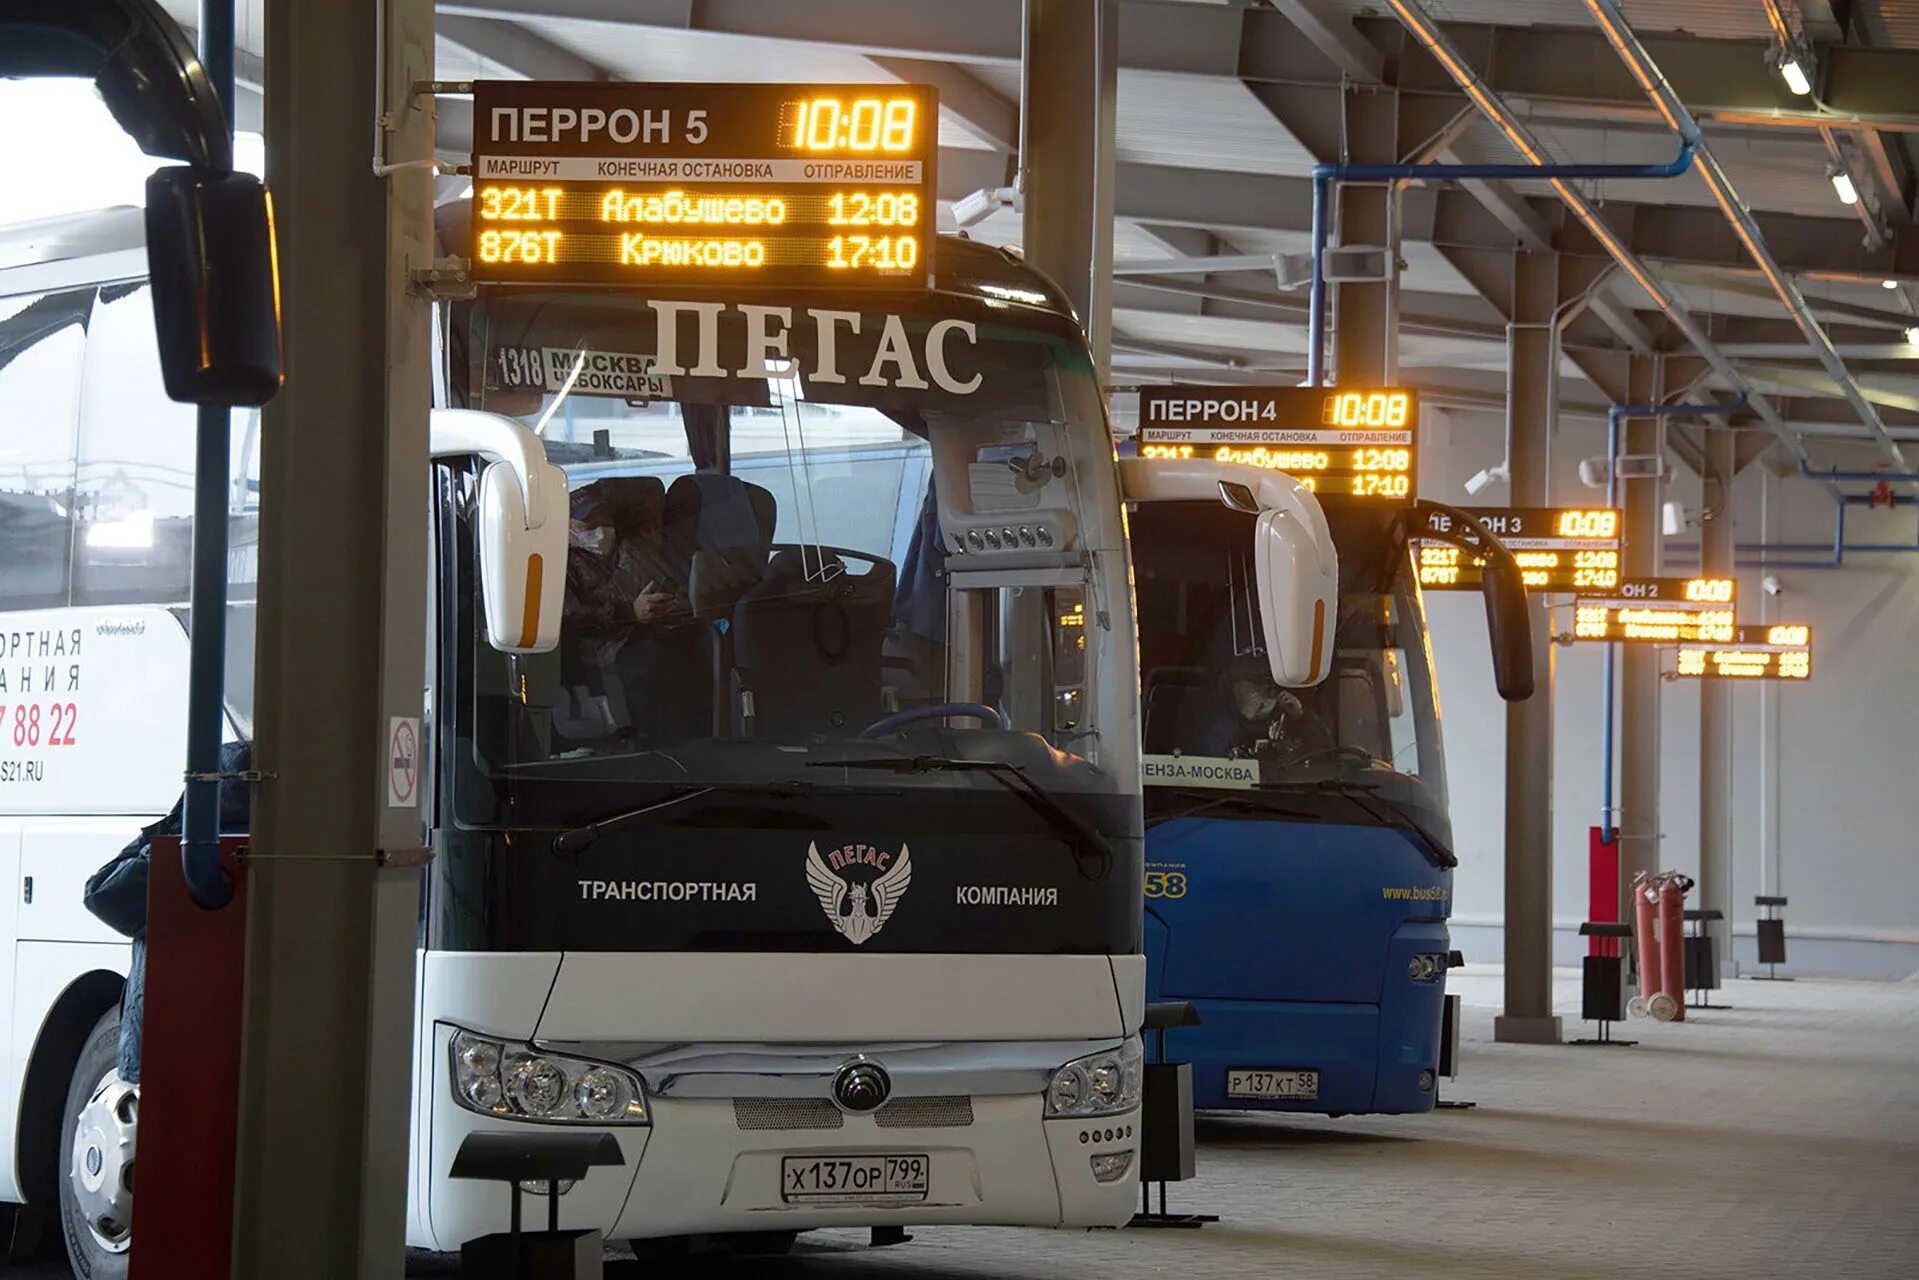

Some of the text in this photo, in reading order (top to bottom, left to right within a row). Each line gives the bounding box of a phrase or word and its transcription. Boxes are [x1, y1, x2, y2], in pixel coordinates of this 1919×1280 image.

[490, 107, 708, 145] ПЕРРОН 5
[794, 99, 915, 151] 10:08
[486, 159, 560, 176] МАРШРУТ
[598, 161, 774, 178] КОНЕЧНАЯ ОСТАНОВКА
[804, 164, 914, 180] ОТПРАВЛЕНИЕ
[480, 189, 917, 226] 321Т Алабушево 12:08
[480, 231, 917, 268] 876Т Крюково 17:10
[647, 300, 983, 395] ПЕГАС
[499, 348, 543, 386] 1318
[554, 371, 663, 393] ЧБОКСАРЫ
[1150, 400, 1277, 421] ПЕРРОН 4
[1333, 394, 1407, 426] 10:08
[1148, 431, 1192, 440] МАРШРУТ
[1210, 432, 1317, 442] КОНЕЧНАЯ ОСТАНОВКА
[1340, 432, 1407, 442] ОТПРАВЛЕНИЕ
[1352, 449, 1408, 470] 12:08
[1352, 475, 1408, 495] 17:10
[1511, 517, 1522, 533] 3
[1560, 511, 1616, 536] 10:08
[14, 704, 40, 746] 88
[48, 703, 77, 745] 22
[828, 844, 890, 871] ПЕГАС
[578, 881, 757, 901] ТРАНСПОРТНАЯ
[957, 886, 1057, 905] КОМПАНИЯ
[1144, 872, 1187, 898] 58
[888, 1160, 920, 1180] 799
